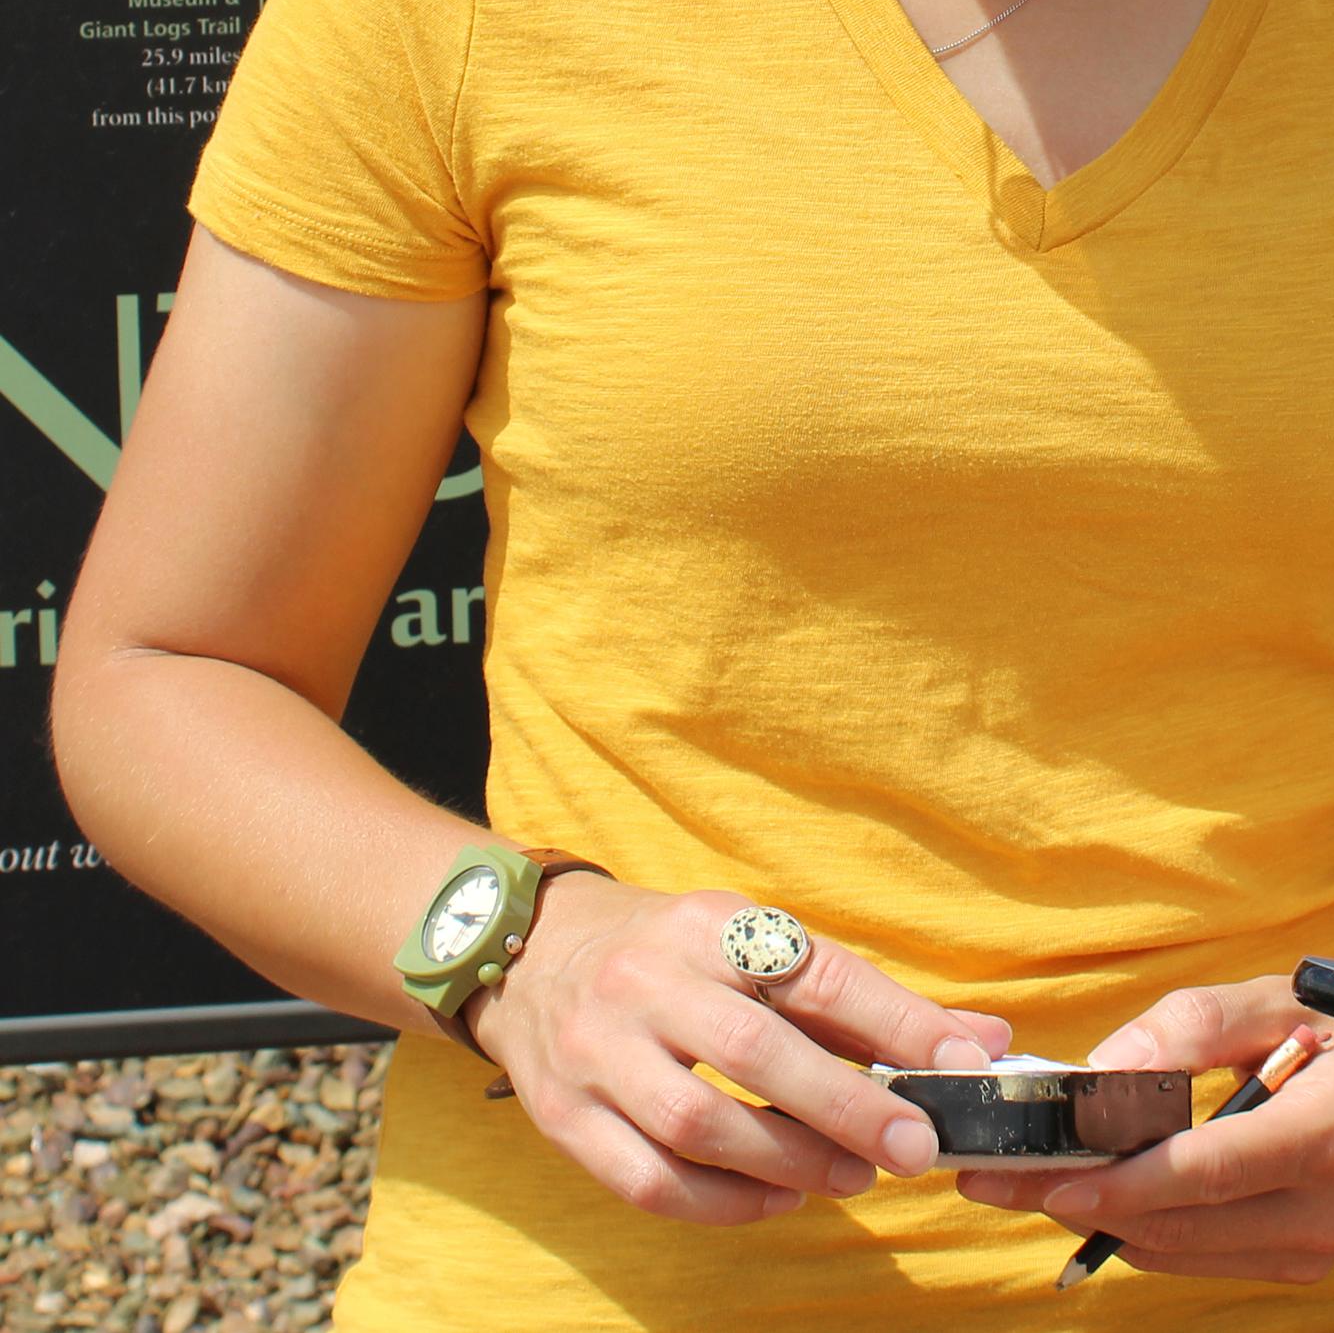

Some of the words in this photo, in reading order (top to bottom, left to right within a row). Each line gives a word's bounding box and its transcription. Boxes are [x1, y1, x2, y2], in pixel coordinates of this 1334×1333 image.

[79, 20, 136, 39] Giant
[143, 19, 191, 42] Logs
[197, 16, 241, 35] Trail
[141, 48, 183, 67] 25.9
[189, 46, 240, 65] miles
[146, 76, 195, 98] (41.7
[92, 108, 140, 127] from
[147, 107, 184, 125] this
